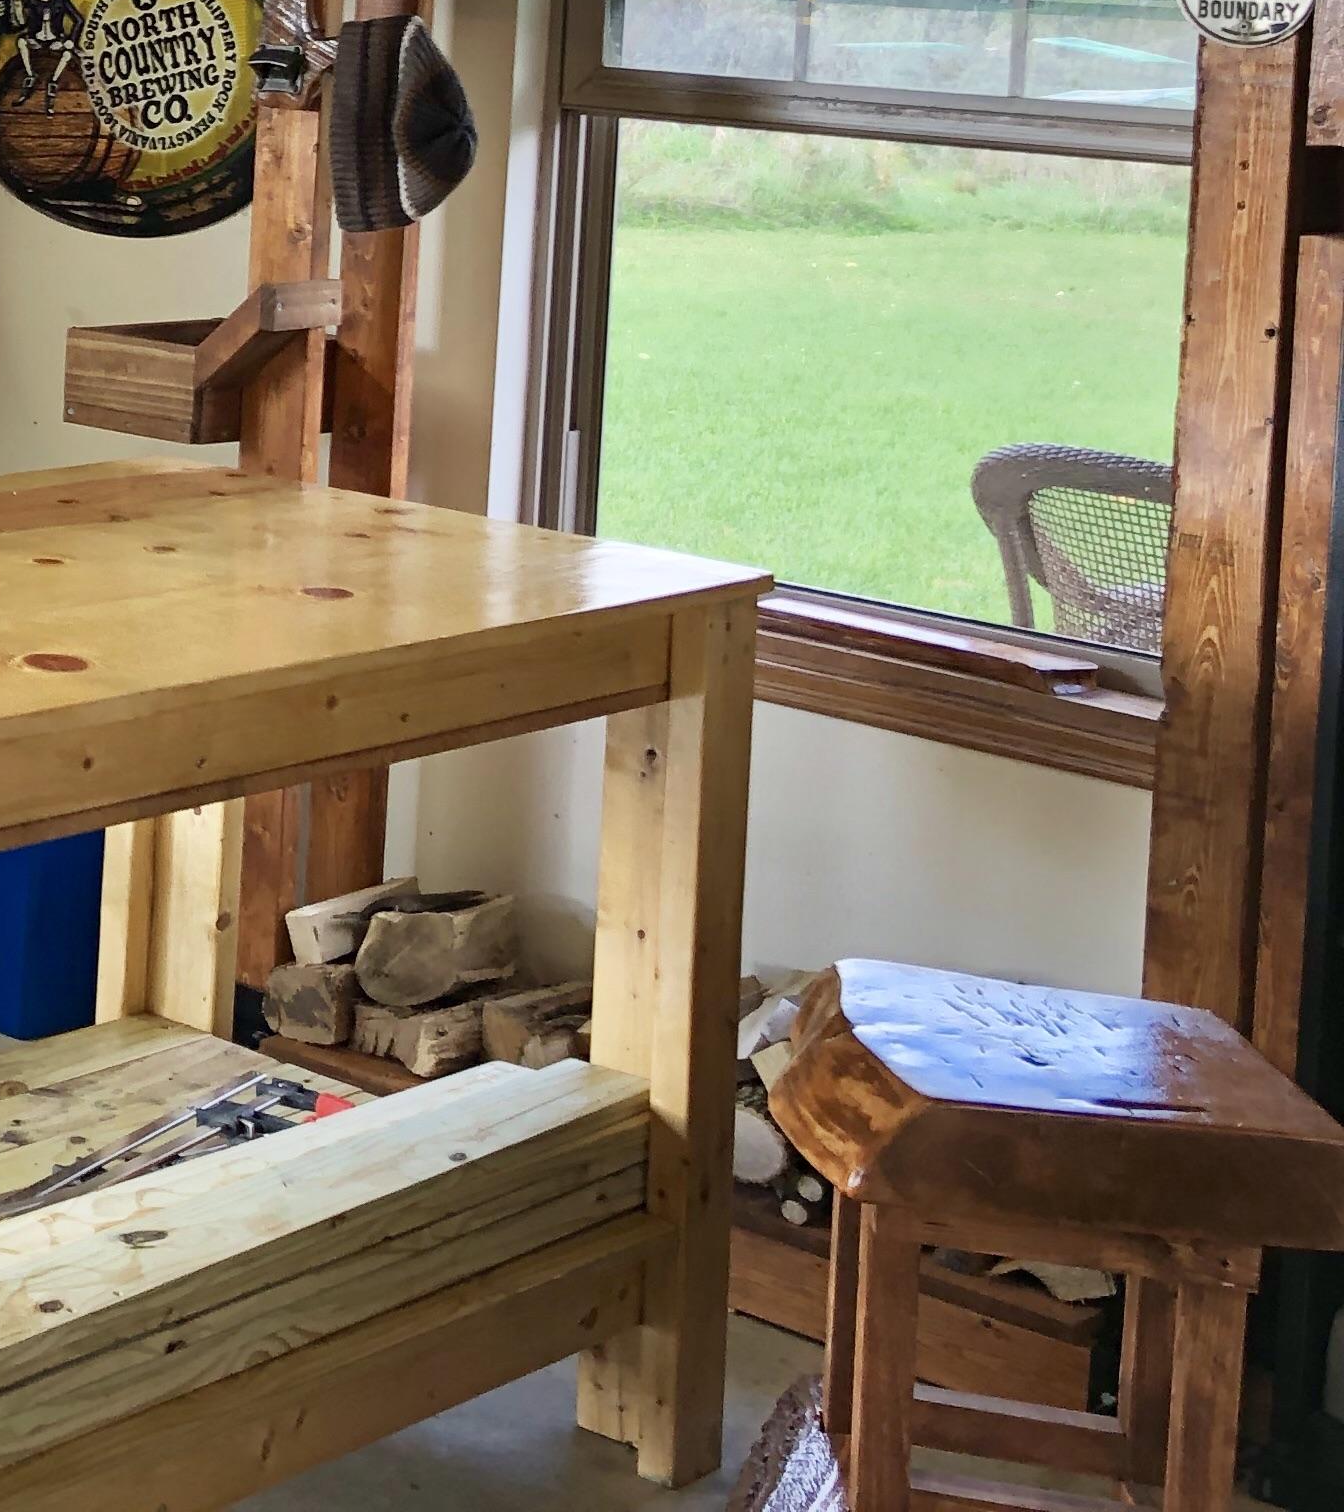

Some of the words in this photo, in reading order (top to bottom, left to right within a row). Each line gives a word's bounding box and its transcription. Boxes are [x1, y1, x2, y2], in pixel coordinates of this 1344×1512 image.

[101, 1, 200, 48] NORTH
[1197, 0, 1300, 22] BOUNDARY
[84, 0, 109, 51] SOUTH
[118, 110, 217, 151] PENNSYLVANIA
[98, 26, 217, 85] COUNTRY
[106, 64, 220, 108] BREWING
[140, 94, 194, 130] CO.
